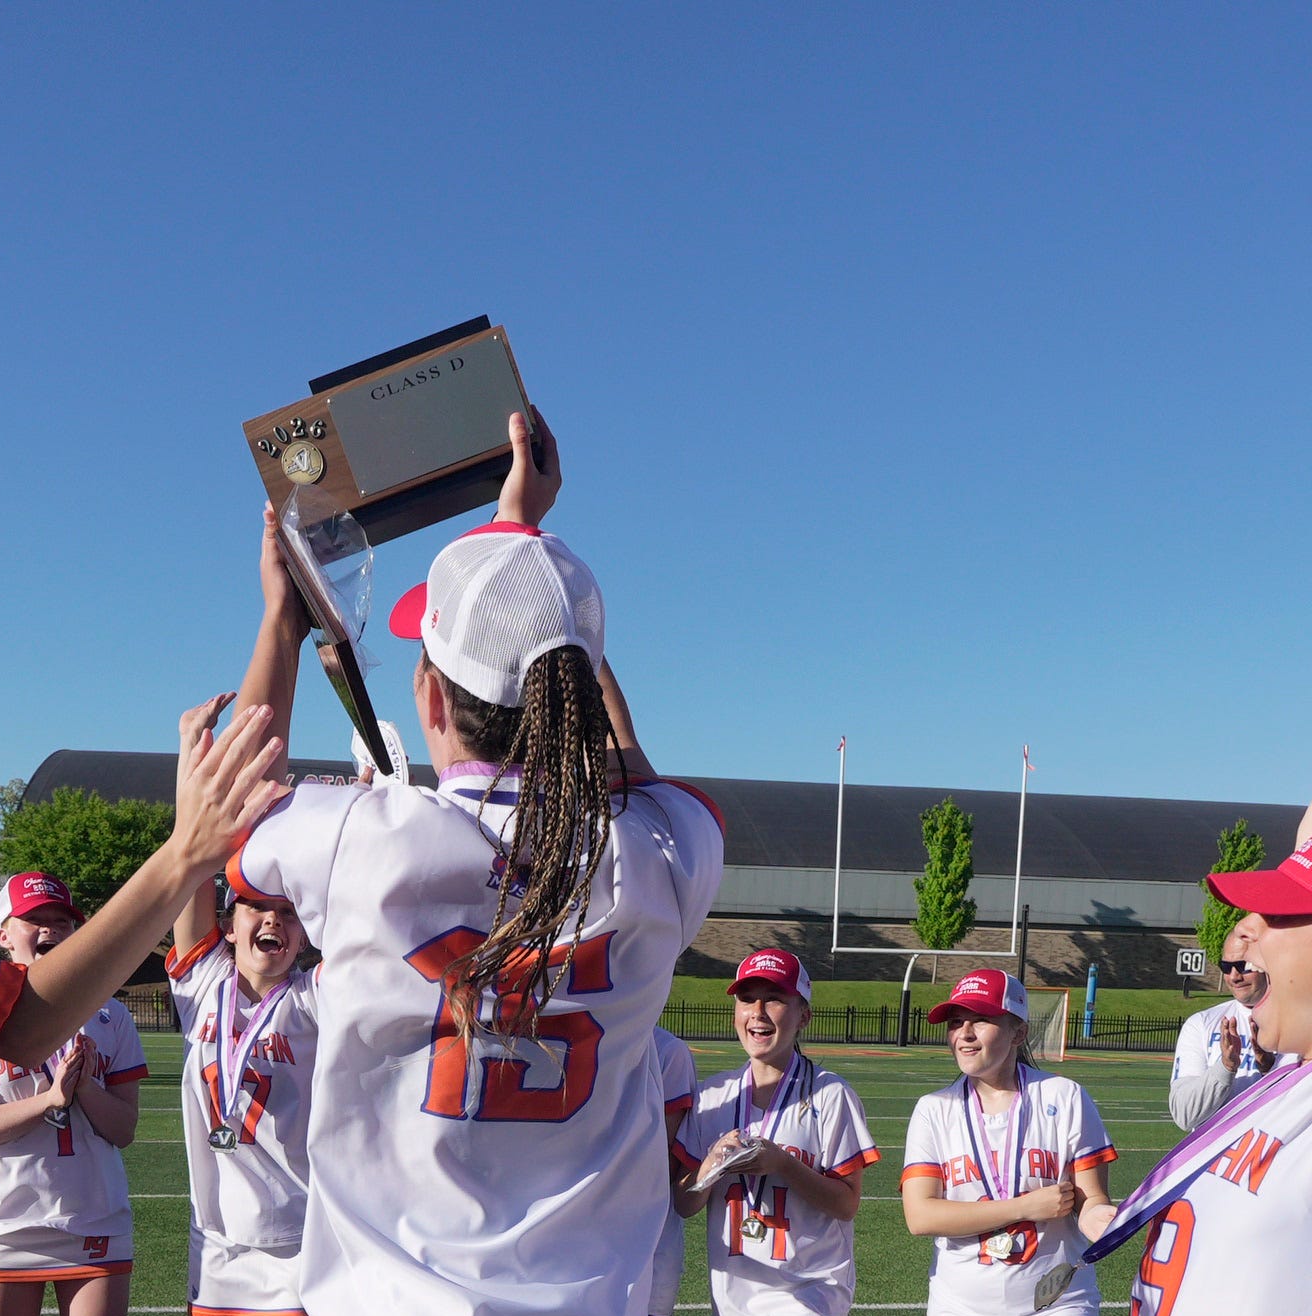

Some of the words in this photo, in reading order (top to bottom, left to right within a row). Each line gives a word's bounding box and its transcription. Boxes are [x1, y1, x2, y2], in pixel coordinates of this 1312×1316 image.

[370, 366, 441, 401] CLASS
[451, 357, 465, 371] D
[258, 417, 326, 458] 2026
[1182, 953, 1202, 972] 90
[403, 925, 618, 1123] 15
[201, 1060, 272, 1145] 17
[1020, 1148, 1059, 1181] AN
[724, 1183, 791, 1261] 14
